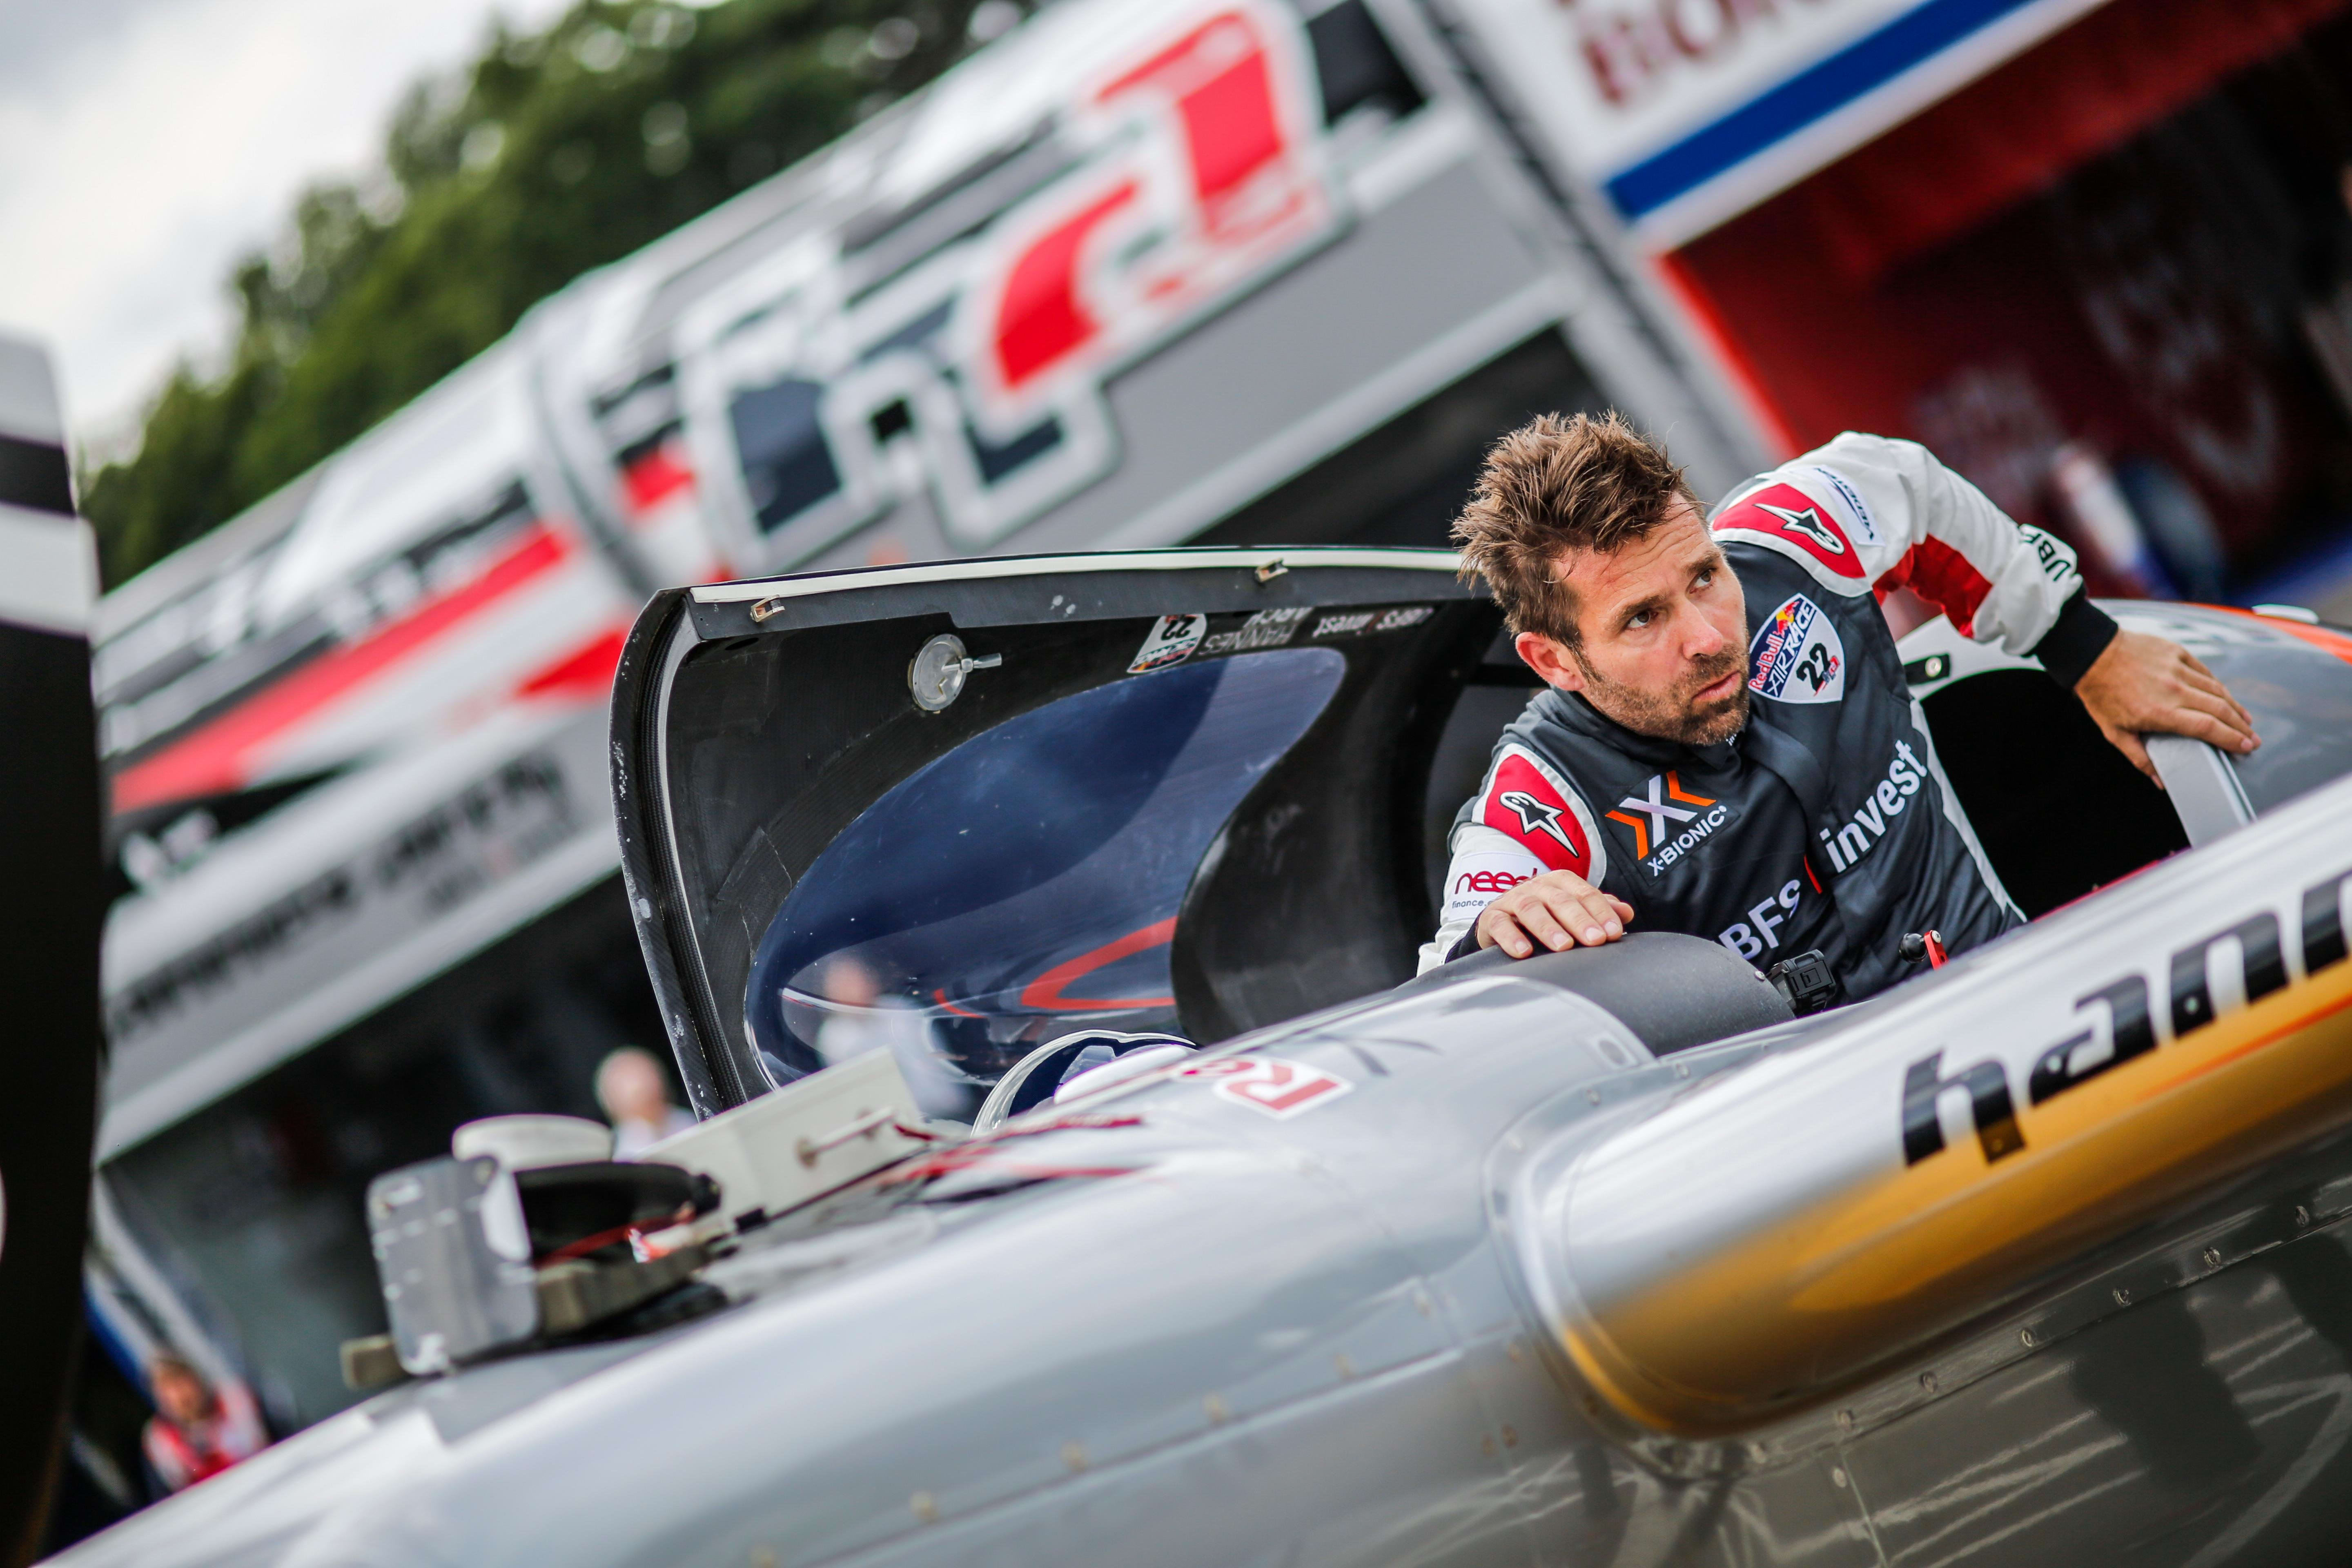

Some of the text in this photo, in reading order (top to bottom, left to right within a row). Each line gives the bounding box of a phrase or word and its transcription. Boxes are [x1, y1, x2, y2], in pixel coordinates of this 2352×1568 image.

[1160, 617, 1197, 641] 22
[1767, 601, 1815, 697] AIR RACE
[1748, 634, 1784, 690] Red Bull
[1796, 643, 1831, 692] 22
[1820, 739, 1927, 873] invest
